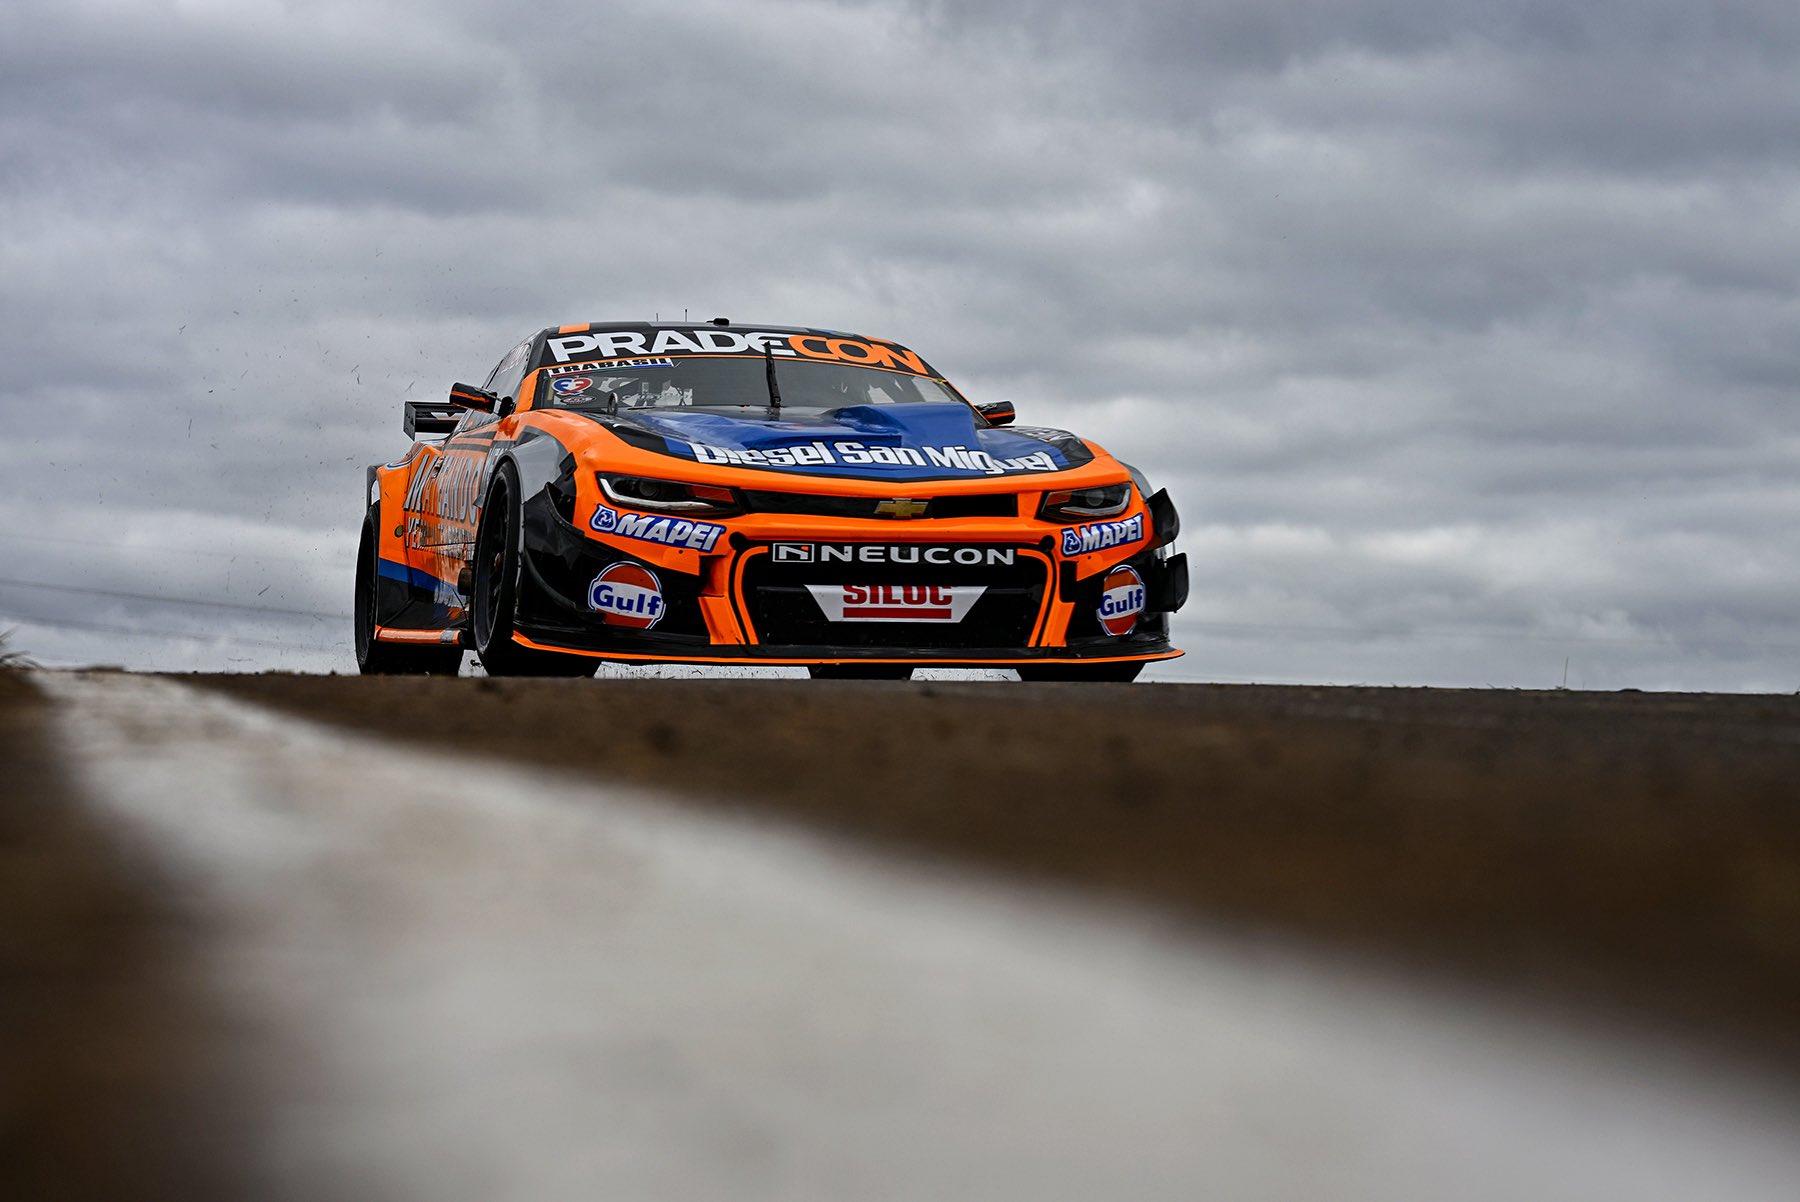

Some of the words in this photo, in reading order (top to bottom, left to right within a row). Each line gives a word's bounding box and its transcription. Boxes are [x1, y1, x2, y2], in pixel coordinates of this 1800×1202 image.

[546, 330, 928, 375] PRADECON
[686, 441, 837, 467] Diesel
[838, 441, 928, 466] San
[922, 446, 1059, 474] Miguel
[615, 514, 722, 551] MAPEI
[1080, 514, 1143, 552] MAPEI
[820, 545, 1014, 565] NEUCON
[593, 584, 662, 616] Gulf
[1100, 588, 1143, 617] Gulf
